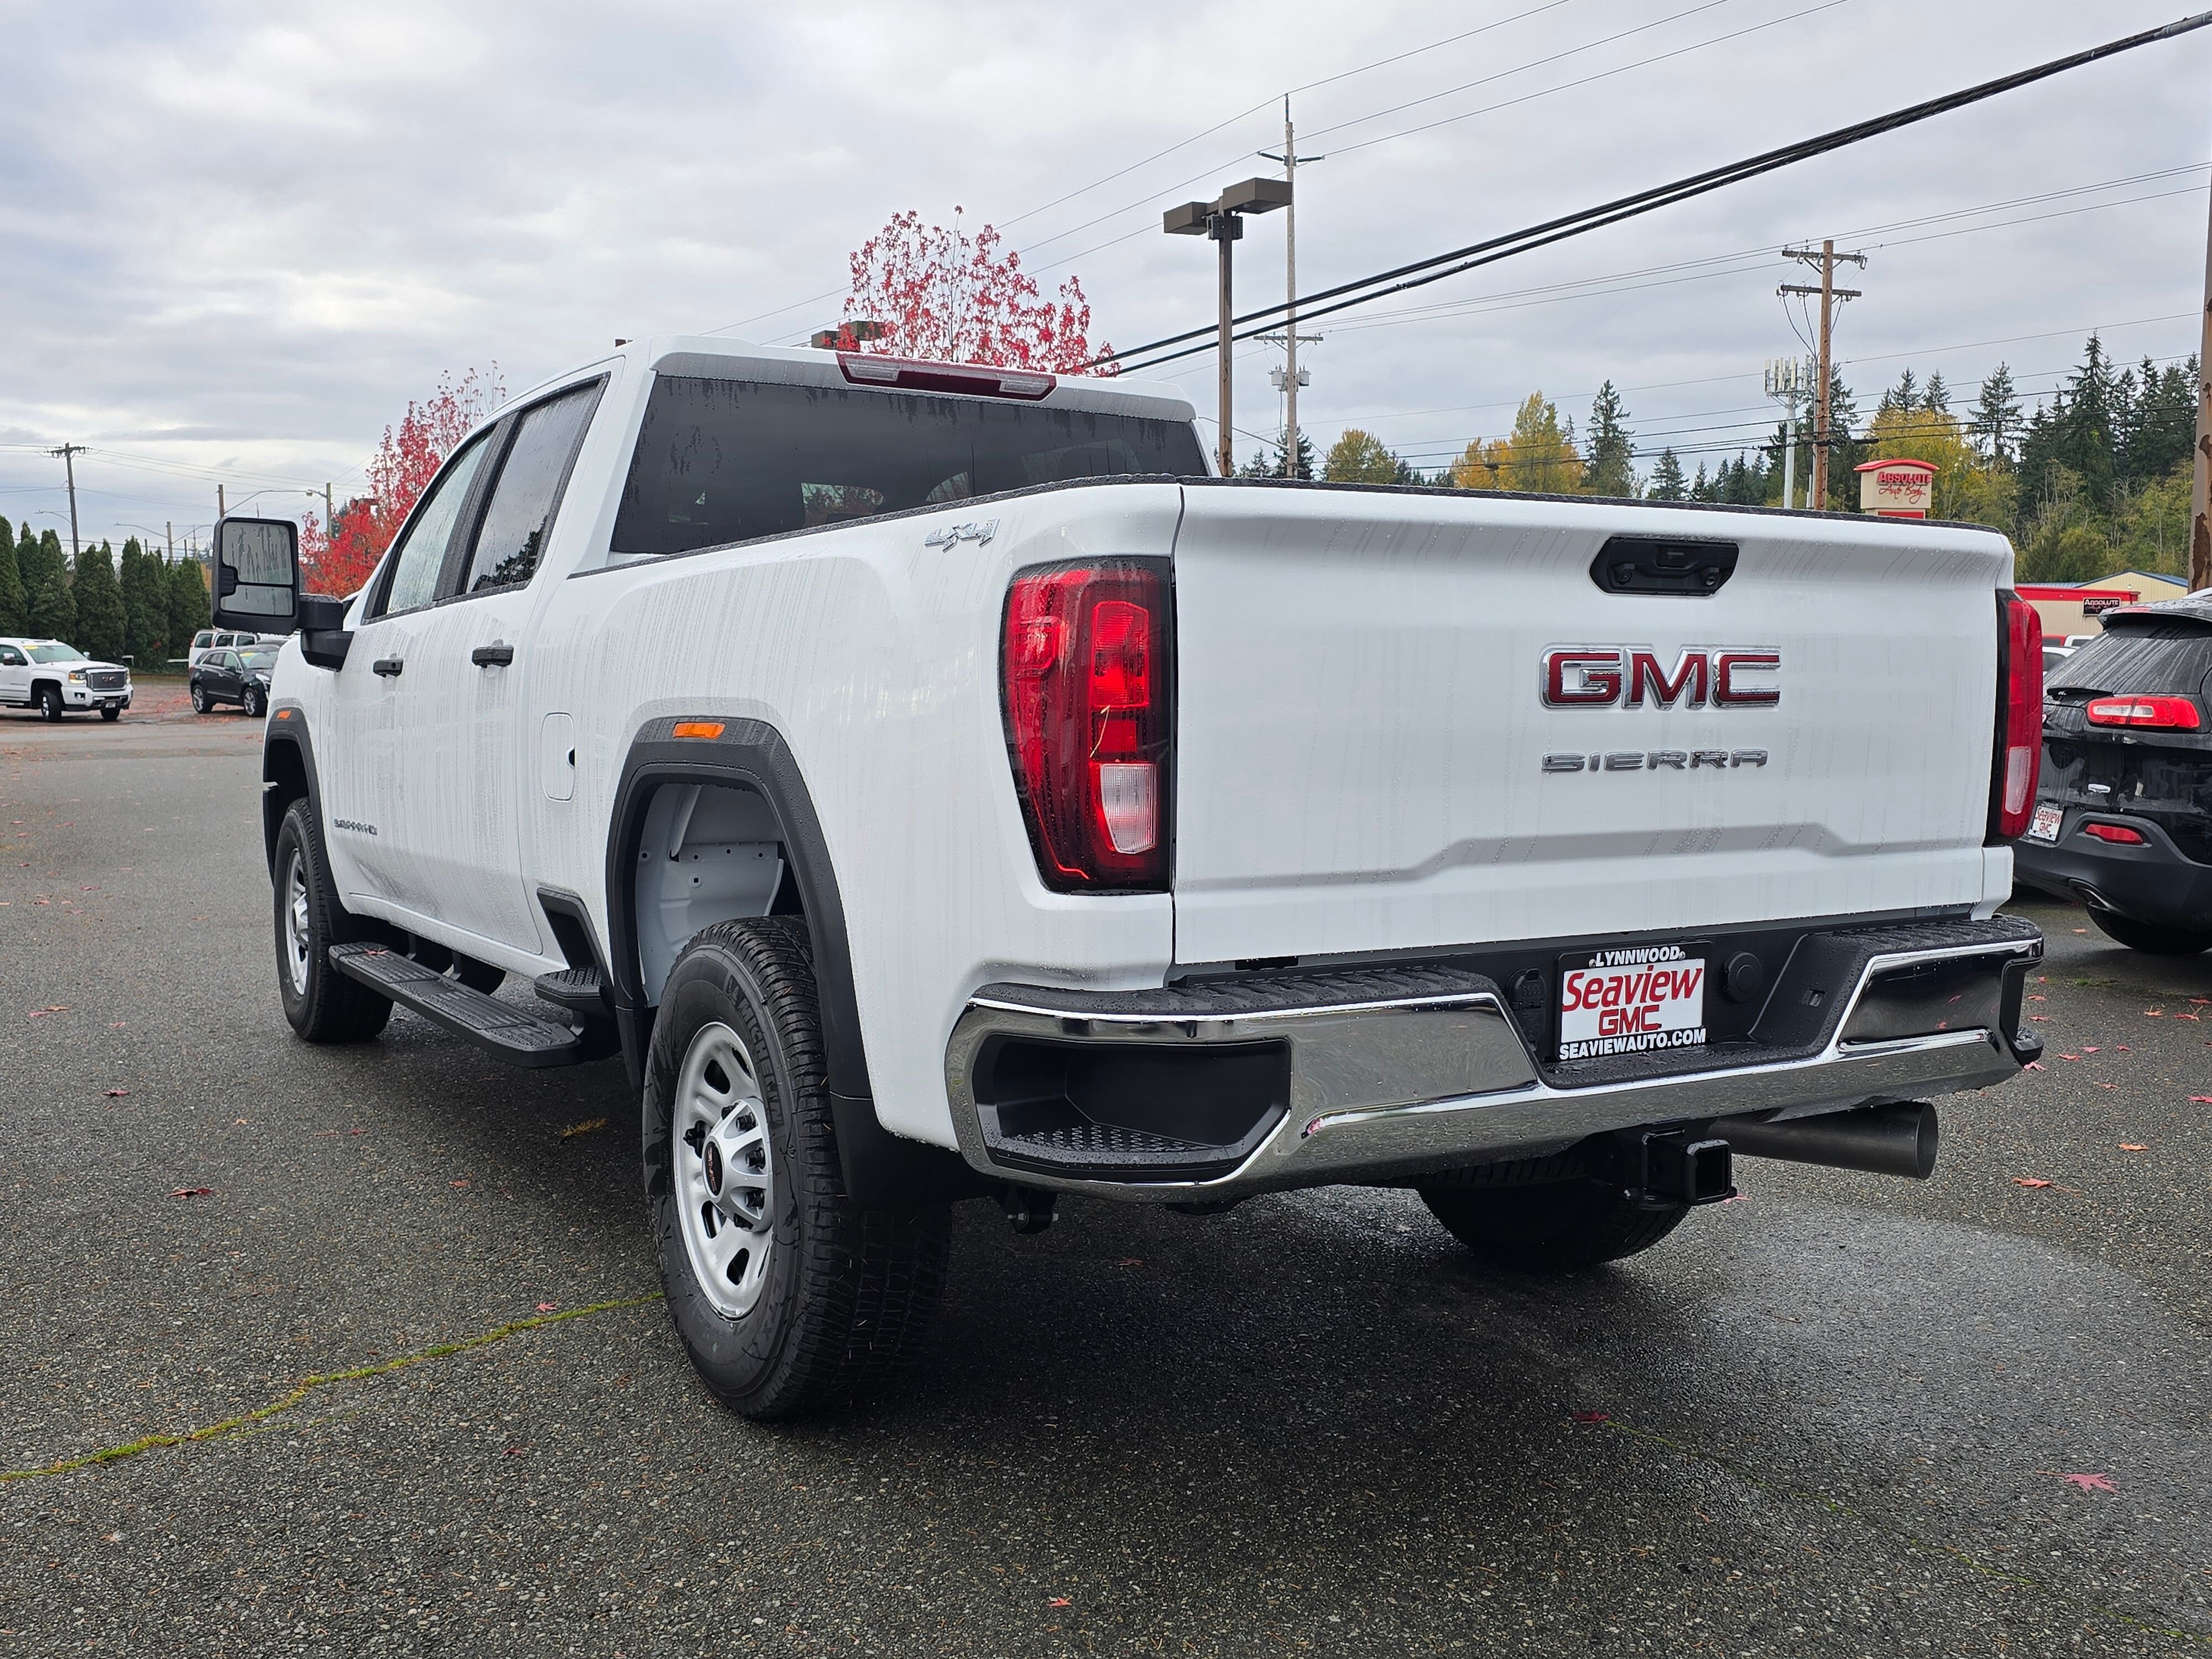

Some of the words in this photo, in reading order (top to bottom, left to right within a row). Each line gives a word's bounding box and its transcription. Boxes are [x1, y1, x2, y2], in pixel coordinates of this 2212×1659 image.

[1877, 471, 1932, 483] ABSOLUTE
[1540, 647, 1781, 711] GMC
[1541, 749, 1768, 773] SIERRA
[2035, 807, 2062, 825] Seaview
[1595, 946, 1680, 967] LYNNWOOD
[1562, 965, 1703, 1011] Seaview
[1599, 1004, 1660, 1036] GMC
[1559, 1028, 1707, 1060] SEAVIEWAUTO.COM
[738, 998, 784, 1125] MICHELIN
